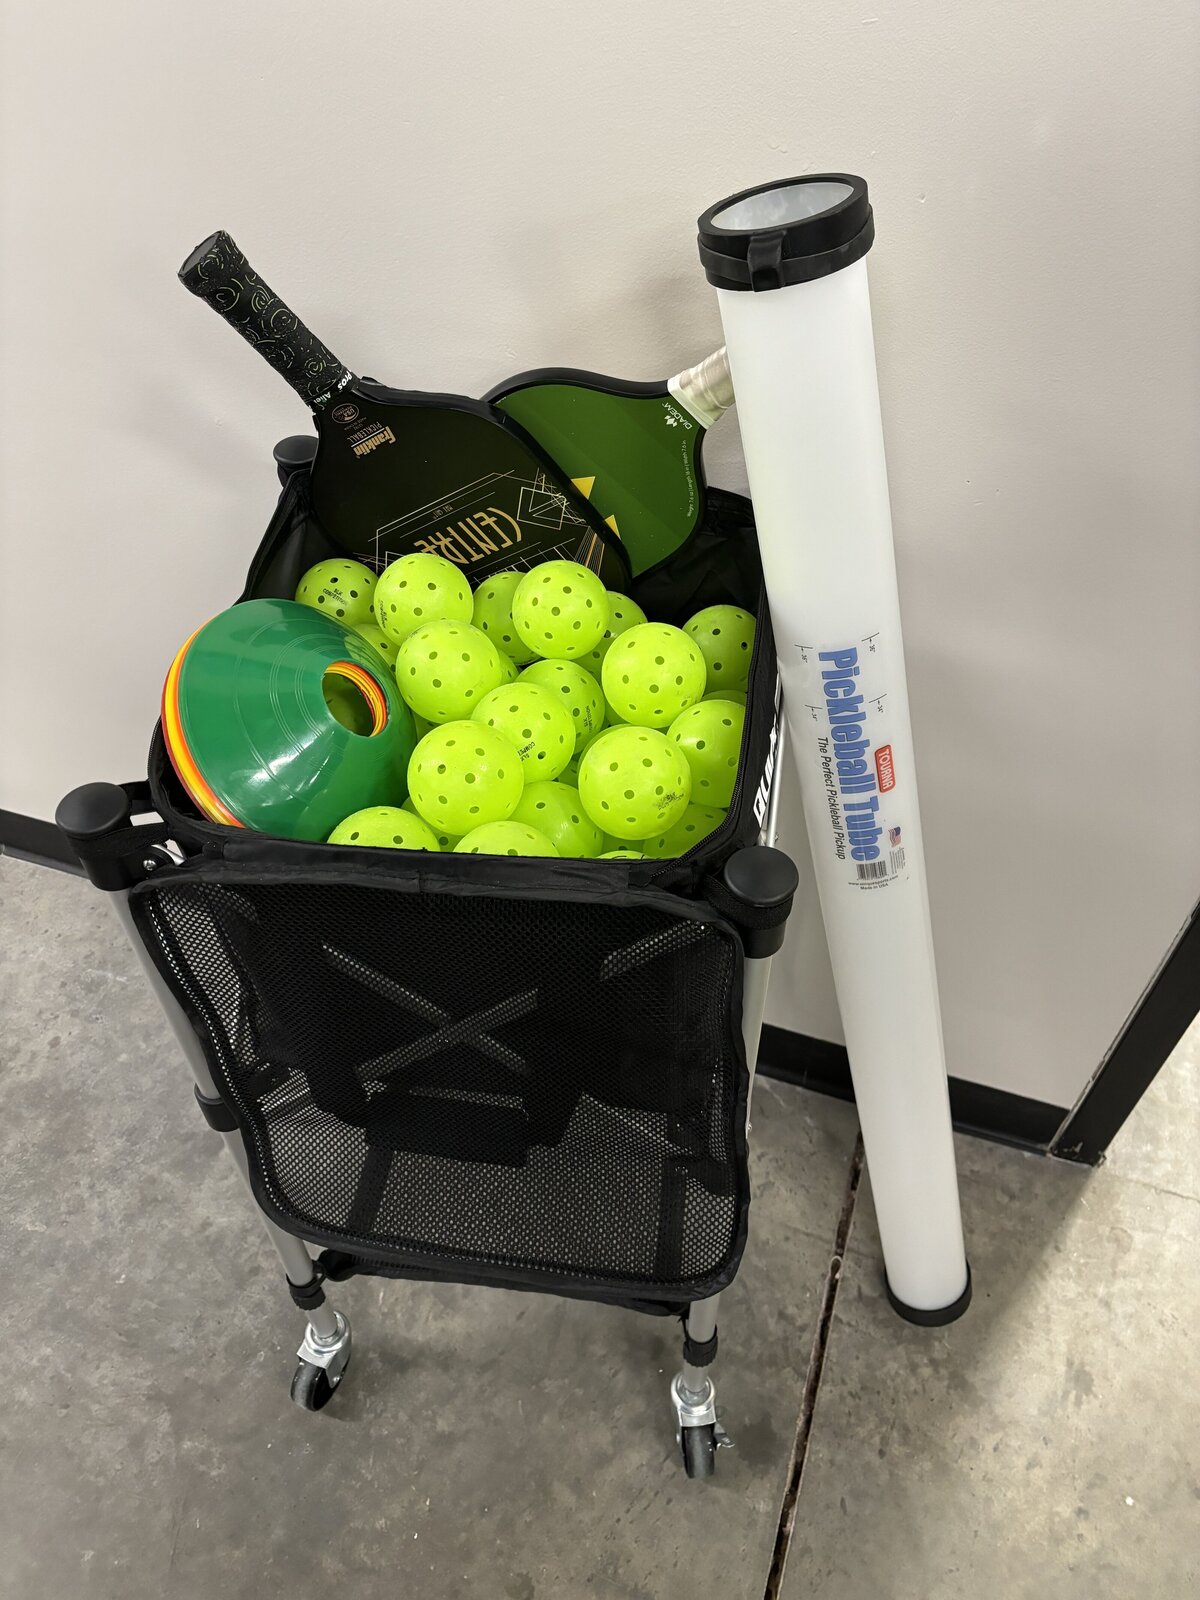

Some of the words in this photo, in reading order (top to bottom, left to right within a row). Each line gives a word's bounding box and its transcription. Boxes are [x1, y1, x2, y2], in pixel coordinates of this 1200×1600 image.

[337, 371, 353, 391] Pros
[663, 403, 693, 430] DIADEM
[347, 421, 383, 443] PICKLEBALL
[353, 426, 396, 456] Franklin
[414, 507, 521, 565] CENTRE
[818, 647, 877, 794] Pickleball
[517, 741, 536, 756] COMPET
[817, 737, 829, 753] The
[822, 755, 835, 788] Perfect
[879, 748, 893, 791] TOURNA
[826, 788, 842, 831] Pickleball
[843, 796, 883, 862] Tube
[833, 831, 846, 860] Pickup
